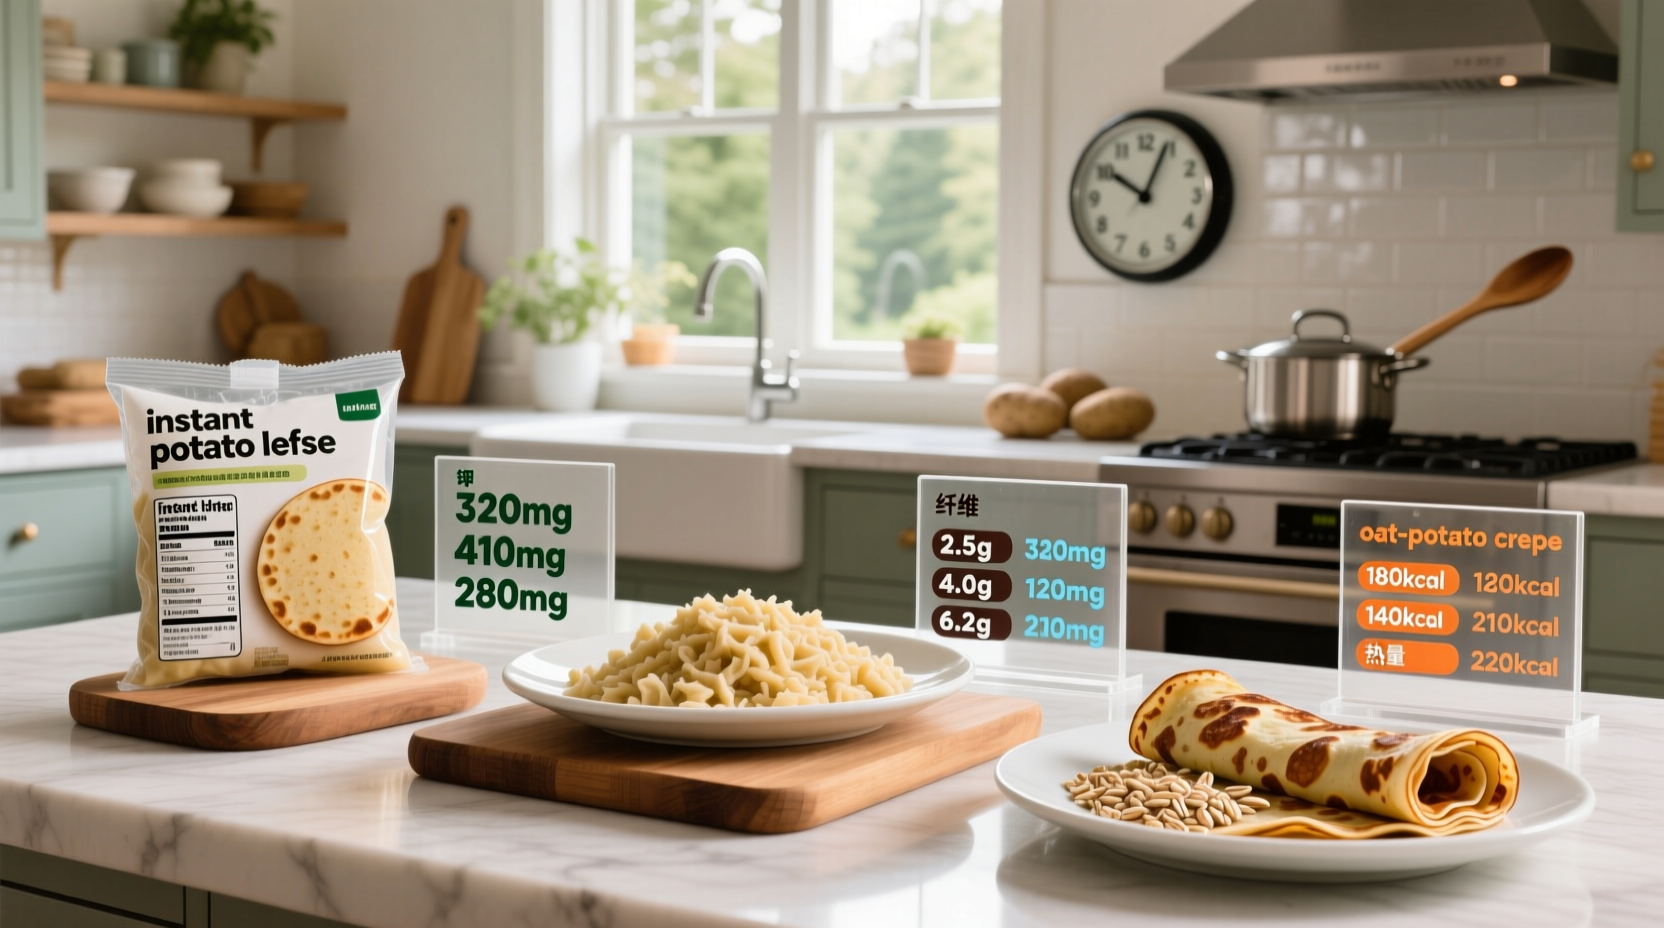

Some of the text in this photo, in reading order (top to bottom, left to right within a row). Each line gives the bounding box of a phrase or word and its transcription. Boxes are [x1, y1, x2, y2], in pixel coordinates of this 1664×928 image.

[1115, 142, 1129, 160] 11
[1137, 133, 1155, 151] 12
[1184, 159, 1196, 178] 2
[1089, 190, 1101, 207] 9
[1191, 187, 1203, 205] 3
[1096, 215, 1108, 234] 8
[1182, 212, 1195, 230] 4
[1114, 233, 1128, 252] 7
[1139, 240, 1150, 259] 6
[1164, 234, 1176, 252] 5
[146, 408, 254, 434] instant
[150, 428, 336, 470] potato lefse
[455, 492, 572, 535] 320mg
[935, 492, 979, 517] 纤维
[940, 534, 992, 563] 2.5g
[1359, 523, 1563, 556] oat-potato crepe
[454, 534, 566, 578] 410mg
[1024, 538, 1106, 570] 320mg
[938, 573, 992, 601] 4.0g
[1366, 566, 1445, 590] 180kcal
[1473, 572, 1560, 597] 120kcal
[455, 576, 568, 621] 280mg
[1025, 578, 1105, 610] 120mg
[939, 610, 991, 640] 6.2g
[1365, 605, 1443, 629] 140kcal
[1471, 611, 1559, 637] 210kcal
[1024, 614, 1105, 648] 210mg
[1470, 650, 1559, 677] 220kcal
